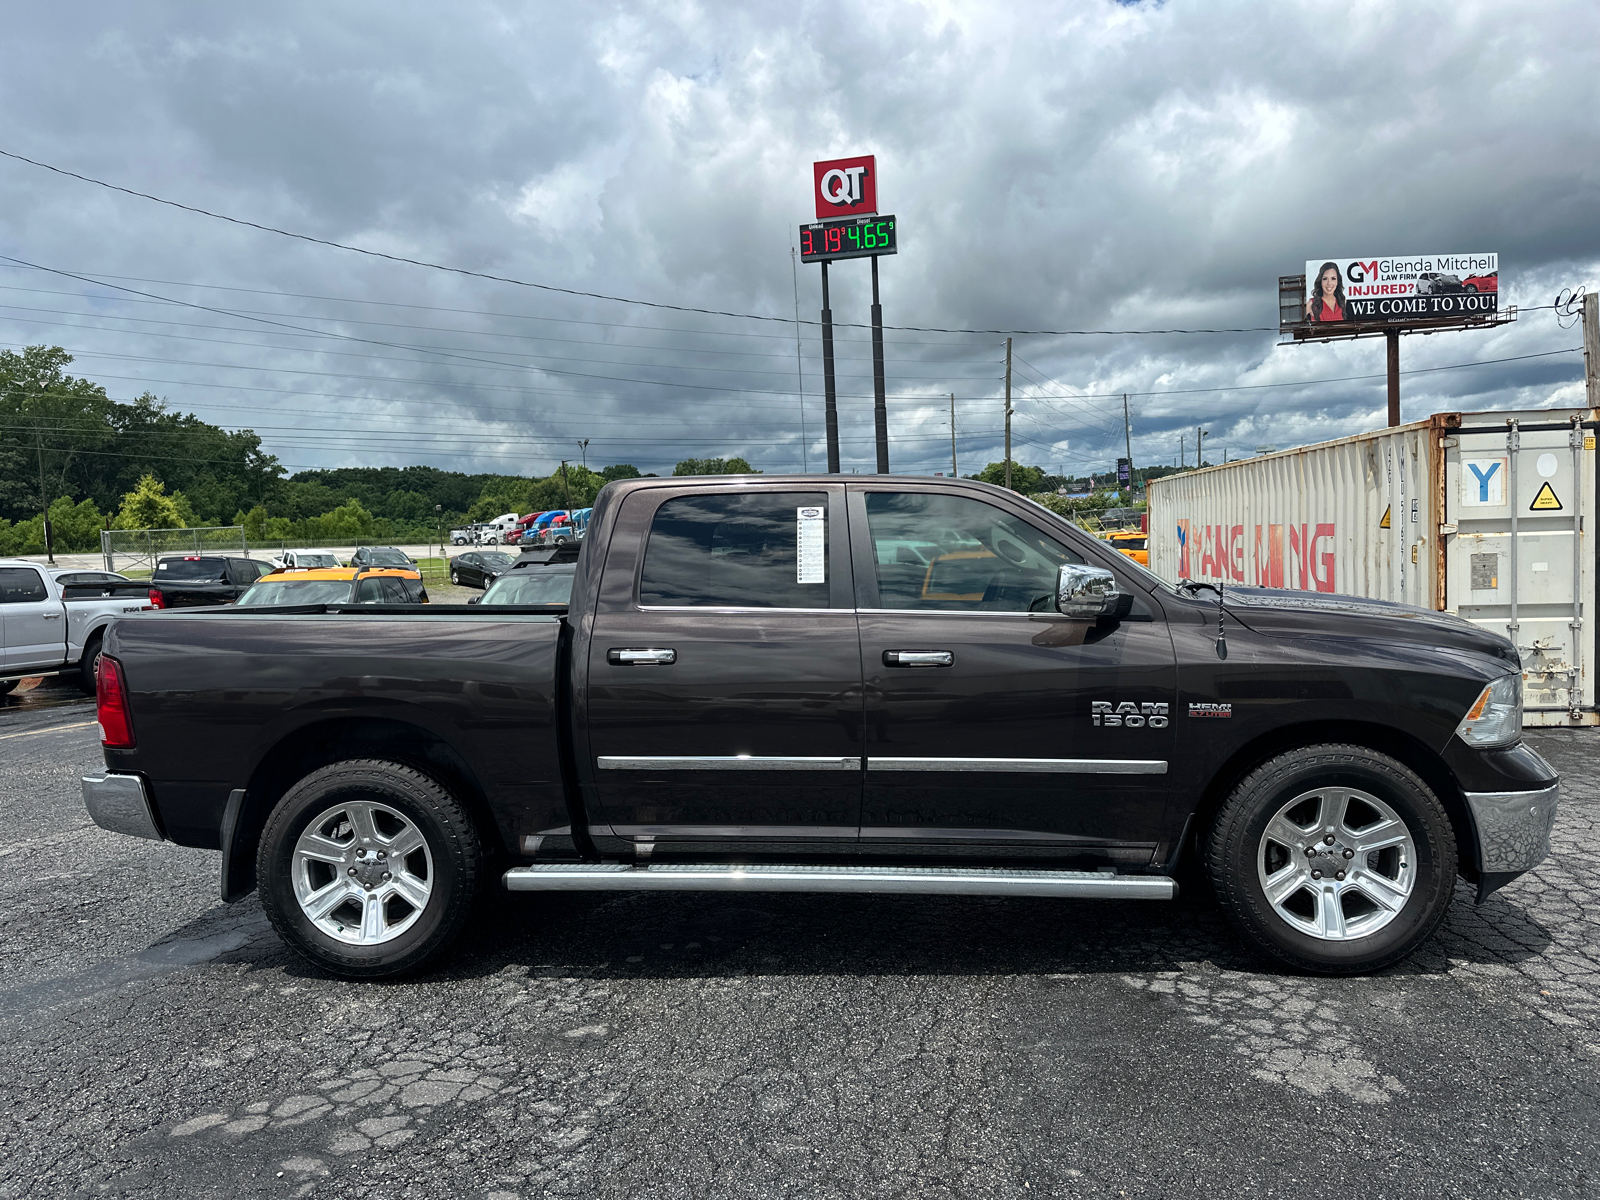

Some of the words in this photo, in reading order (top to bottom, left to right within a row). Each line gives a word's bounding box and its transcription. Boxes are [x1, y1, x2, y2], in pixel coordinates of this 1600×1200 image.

[820, 166, 867, 206] QT
[1379, 257, 1433, 273] Glenda
[1437, 255, 1495, 271] Mitchell
[1381, 273, 1399, 281] LAW
[1399, 272, 1418, 281] FIRM
[1348, 283, 1415, 297] INJURED?
[1350, 300, 1376, 316] WE
[1378, 298, 1428, 314] COME
[1430, 297, 1454, 312] TO
[1456, 295, 1496, 311] YOU!
[1091, 700, 1169, 715] RAM
[1188, 702, 1232, 711] HEMI
[1091, 714, 1169, 729] 1500
